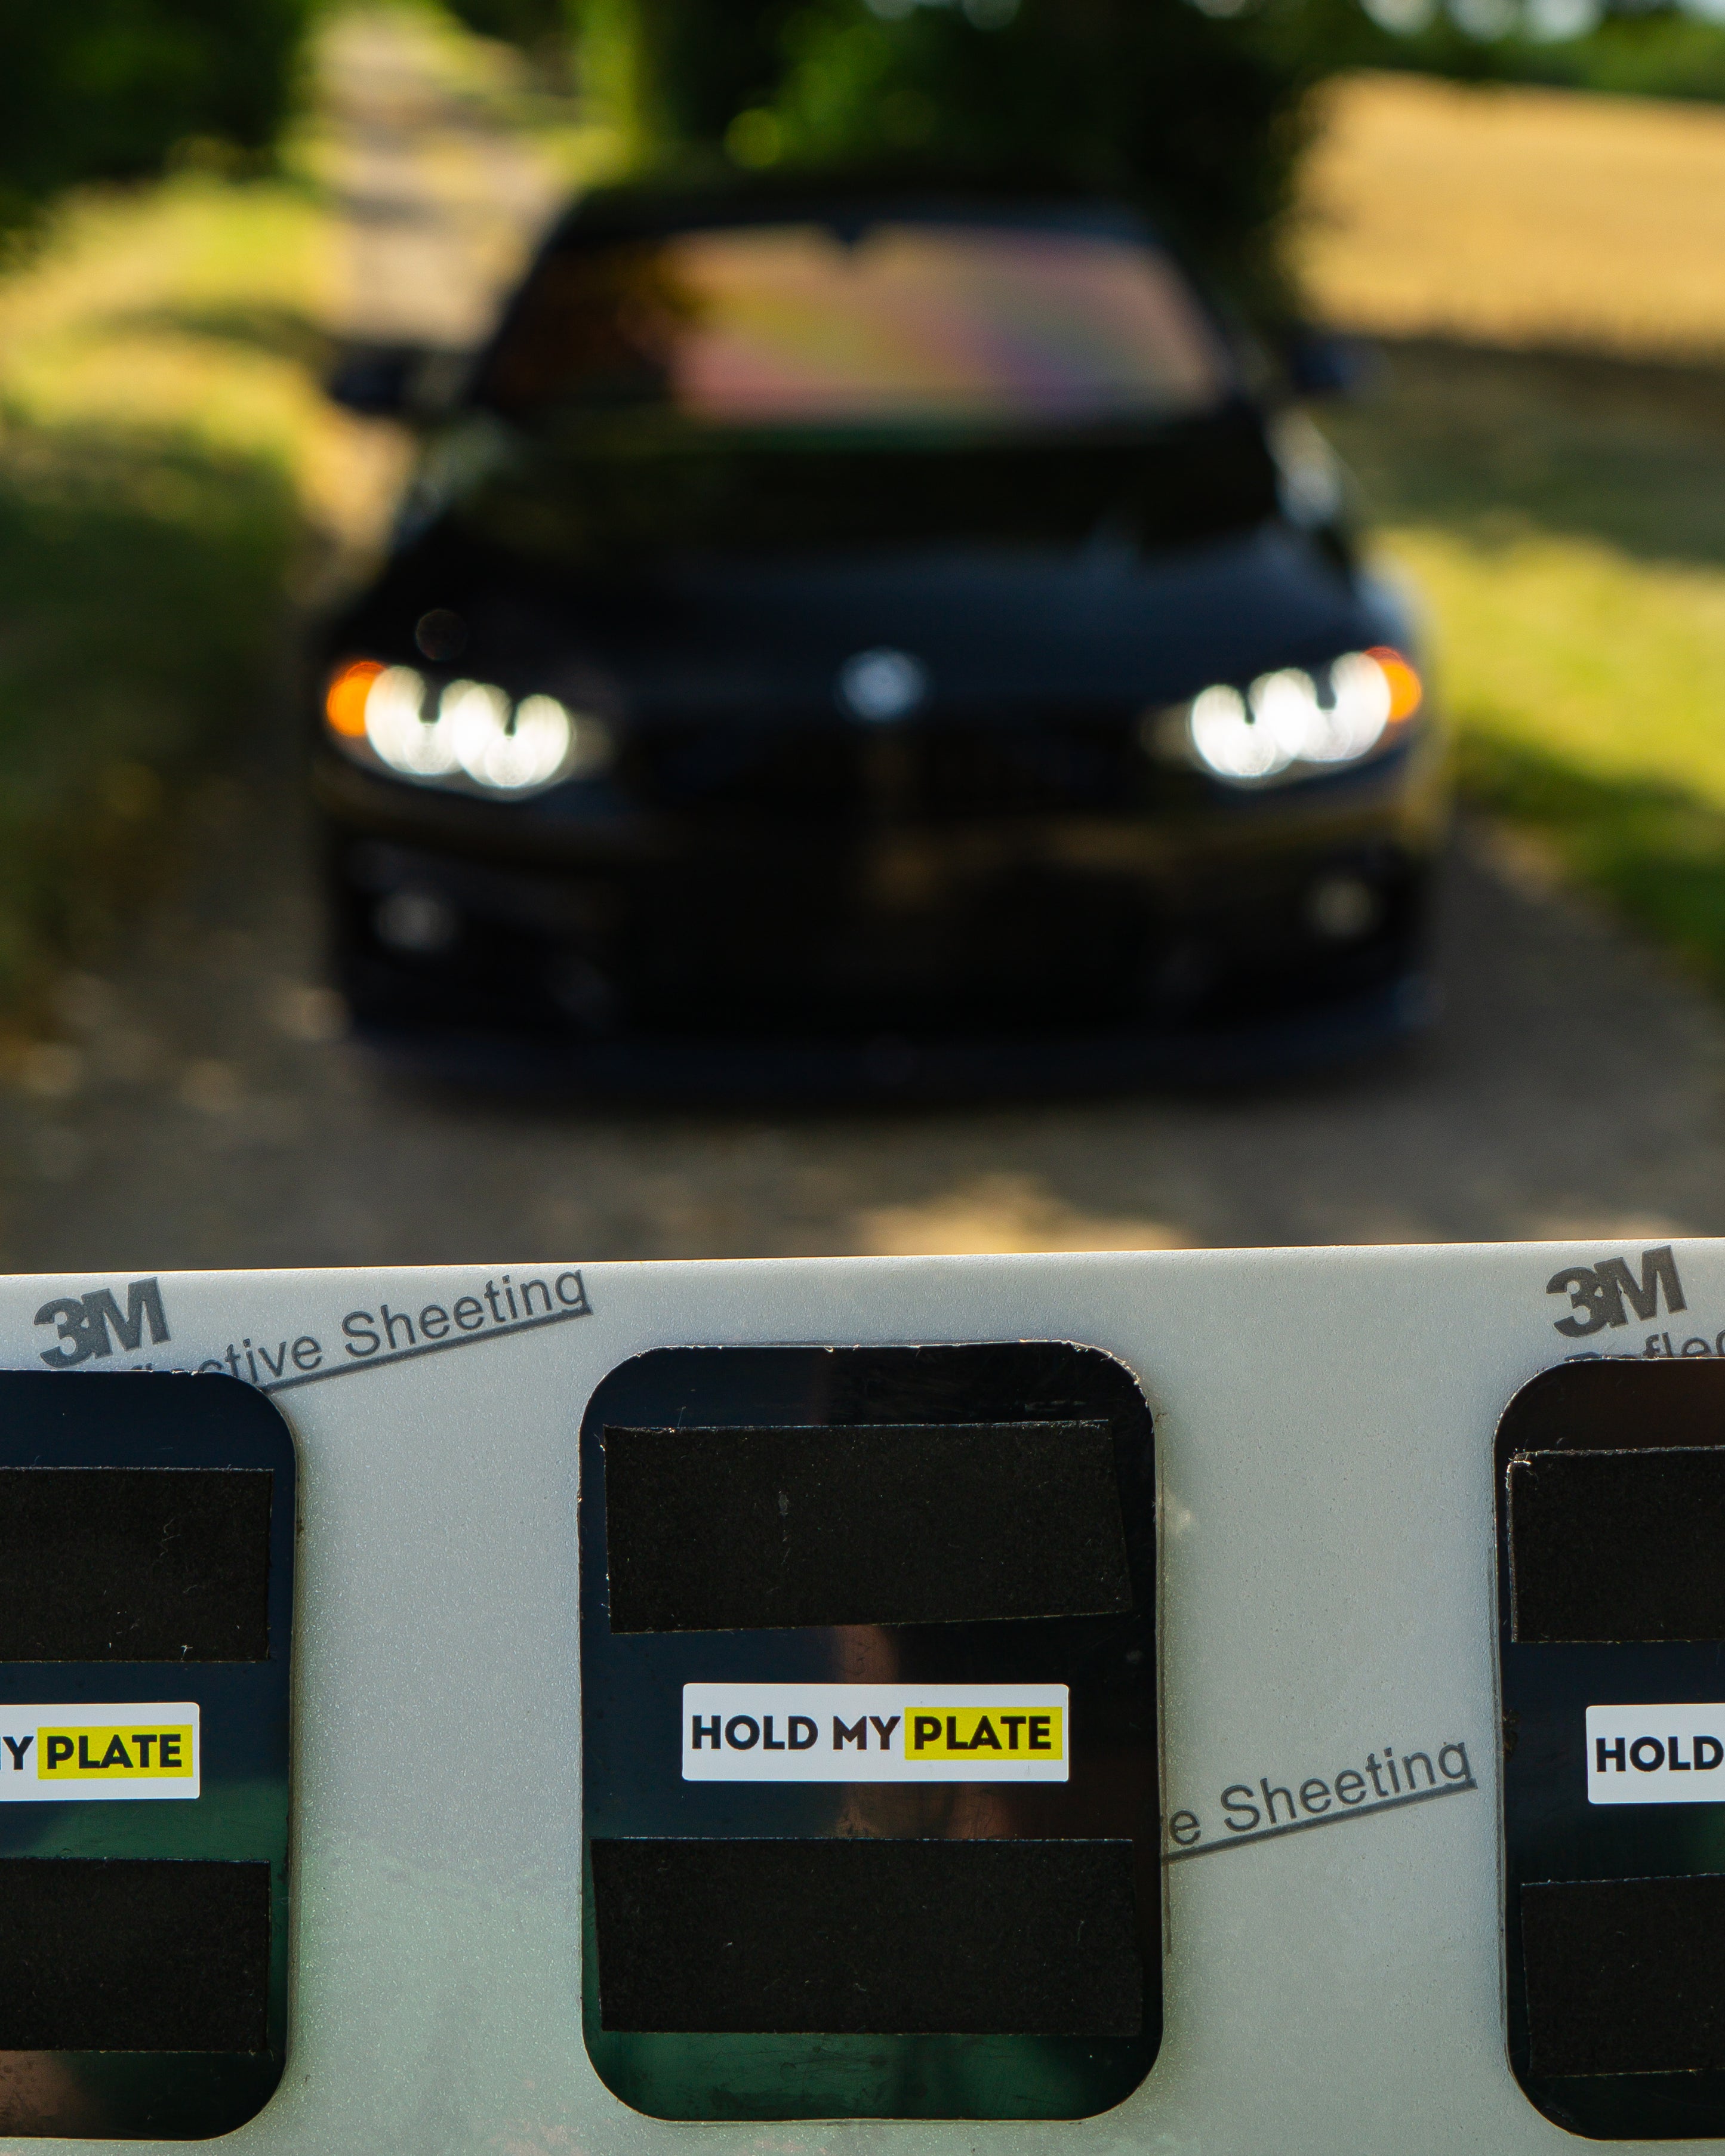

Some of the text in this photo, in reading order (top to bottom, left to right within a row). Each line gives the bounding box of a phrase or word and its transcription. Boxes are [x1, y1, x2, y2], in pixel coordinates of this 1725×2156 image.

[34, 1277, 171, 1368] 3M
[341, 1270, 589, 1357] Sheeting
[1546, 1245, 1687, 1337] 3M
[0, 1734, 182, 1770] Y PLATE
[692, 1714, 1051, 1751] HOLD MY PLATE
[1596, 1735, 1724, 1772] HOLD
[1221, 1742, 1475, 1831] Sheeting
